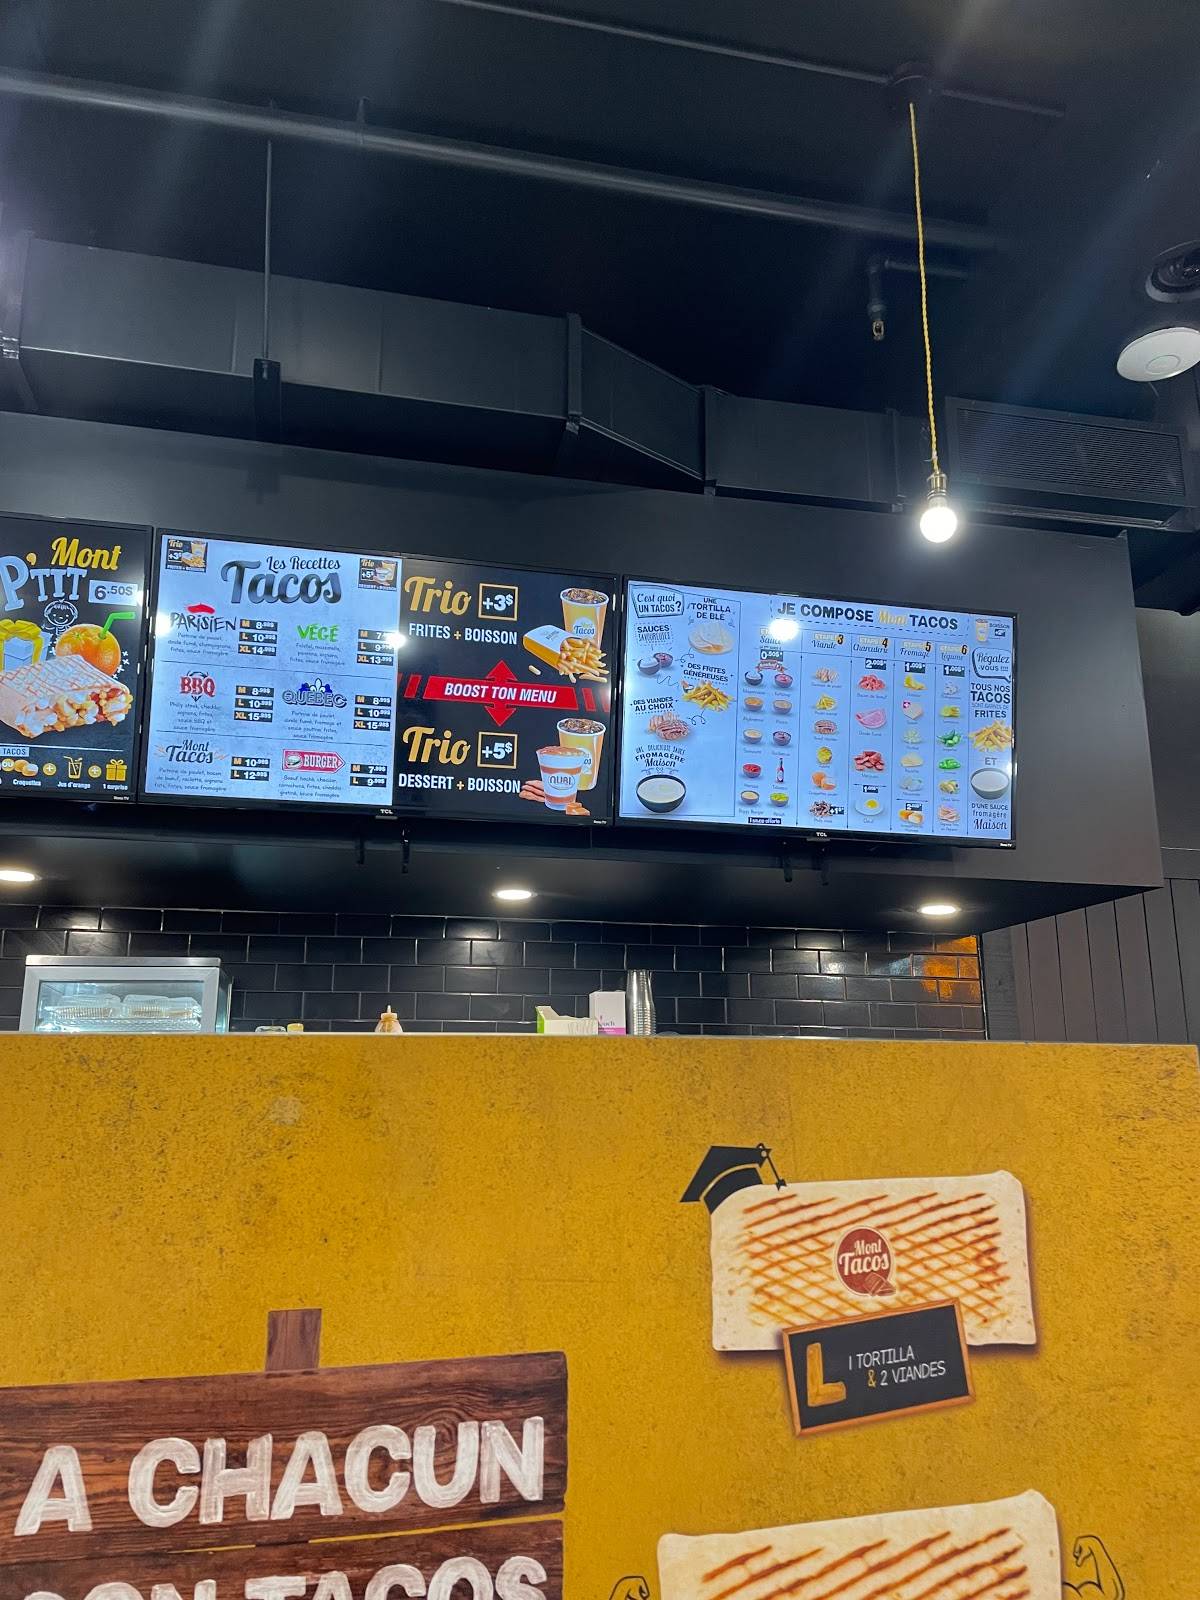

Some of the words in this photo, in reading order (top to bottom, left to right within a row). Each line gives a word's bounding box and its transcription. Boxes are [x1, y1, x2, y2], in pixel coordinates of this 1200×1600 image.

[51, 537, 121, 571] Mont
[266, 556, 286, 573] Les
[290, 556, 341, 570] Recettes
[221, 560, 342, 605] Tacos
[94, 585, 133, 600] 6.50$
[404, 576, 471, 615] Trio
[656, 593, 676, 605] quoi
[639, 604, 649, 613] UN
[691, 602, 731, 613] TORTILLA
[777, 602, 796, 615] JE
[800, 604, 874, 622] COMPOSE
[909, 614, 958, 630] TACOS
[241, 620, 250, 628] M
[574, 625, 595, 635] Tacos
[637, 624, 670, 633] SAUCES
[409, 623, 451, 639] FRITES
[464, 628, 517, 645] BOISSON
[837, 634, 844, 645] 3
[239, 645, 251, 653] XL
[811, 640, 837, 650] Viande
[882, 638, 889, 648] 4
[925, 641, 932, 652] 5
[900, 647, 929, 659] Fromage
[961, 644, 968, 655] 6
[357, 655, 369, 663] XL
[976, 652, 1010, 665] Régalez
[687, 662, 701, 670] DES
[702, 666, 726, 674] FRITES
[180, 677, 216, 697] BBQ
[444, 683, 488, 697] BOOST
[491, 686, 517, 700] TON
[519, 689, 557, 703] MENU
[971, 682, 991, 691] TOUS
[994, 685, 1011, 693] NOS
[356, 695, 365, 703] M
[633, 698, 643, 706] DES
[646, 696, 674, 705] VIANDES
[970, 691, 1011, 704] TACOS
[635, 704, 646, 712] AU
[649, 702, 674, 710] CHOIX
[235, 711, 247, 719] XL
[975, 710, 1007, 718] FRITES
[354, 721, 366, 729] XL
[181, 740, 209, 752] Mont
[402, 726, 471, 765] Trio
[3, 748, 26, 756] TACOS
[166, 745, 213, 763] Tacos
[303, 754, 339, 769] BURGER
[645, 758, 676, 767] Maison
[984, 757, 997, 765] ET
[398, 773, 454, 790] DESSERT
[467, 778, 521, 793] BOISSON
[971, 802, 988, 810] D'UNE
[973, 819, 1008, 830] Maison
[854, 1239, 882, 1256] Mont
[838, 1252, 890, 1276] Tacos
[856, 1345, 915, 1369] TORTILLA
[806, 1342, 847, 1407] L
[867, 1369, 877, 1388] &
[880, 1370, 888, 1386] 2
[892, 1361, 947, 1383] VIANDES
[15, 1446, 92, 1536] A
[128, 1416, 544, 1527] CHACUN
